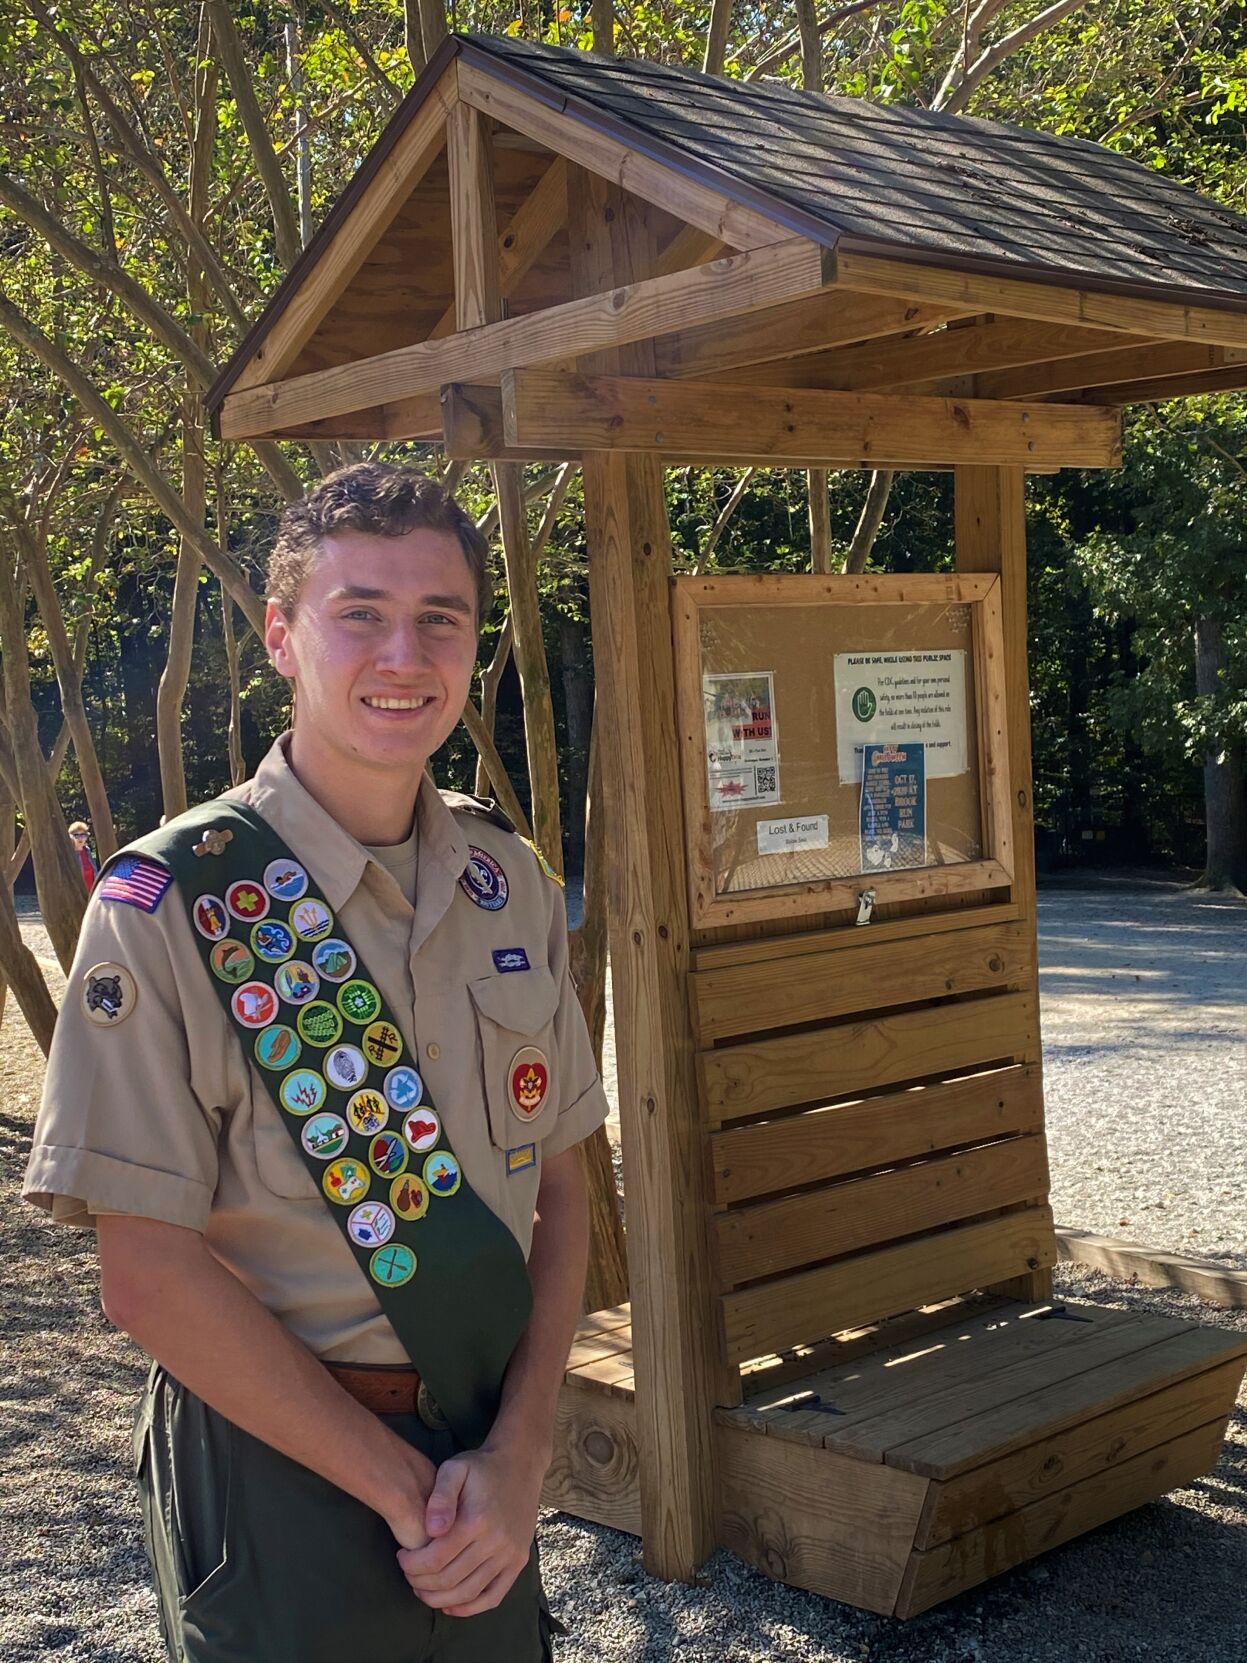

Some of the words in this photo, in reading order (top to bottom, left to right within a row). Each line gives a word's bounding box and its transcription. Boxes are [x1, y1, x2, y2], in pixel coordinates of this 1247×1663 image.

[752, 712, 771, 720] RUN
[769, 823, 787, 835] Lost
[788, 823, 795, 833] &
[796, 820, 818, 832] Found
